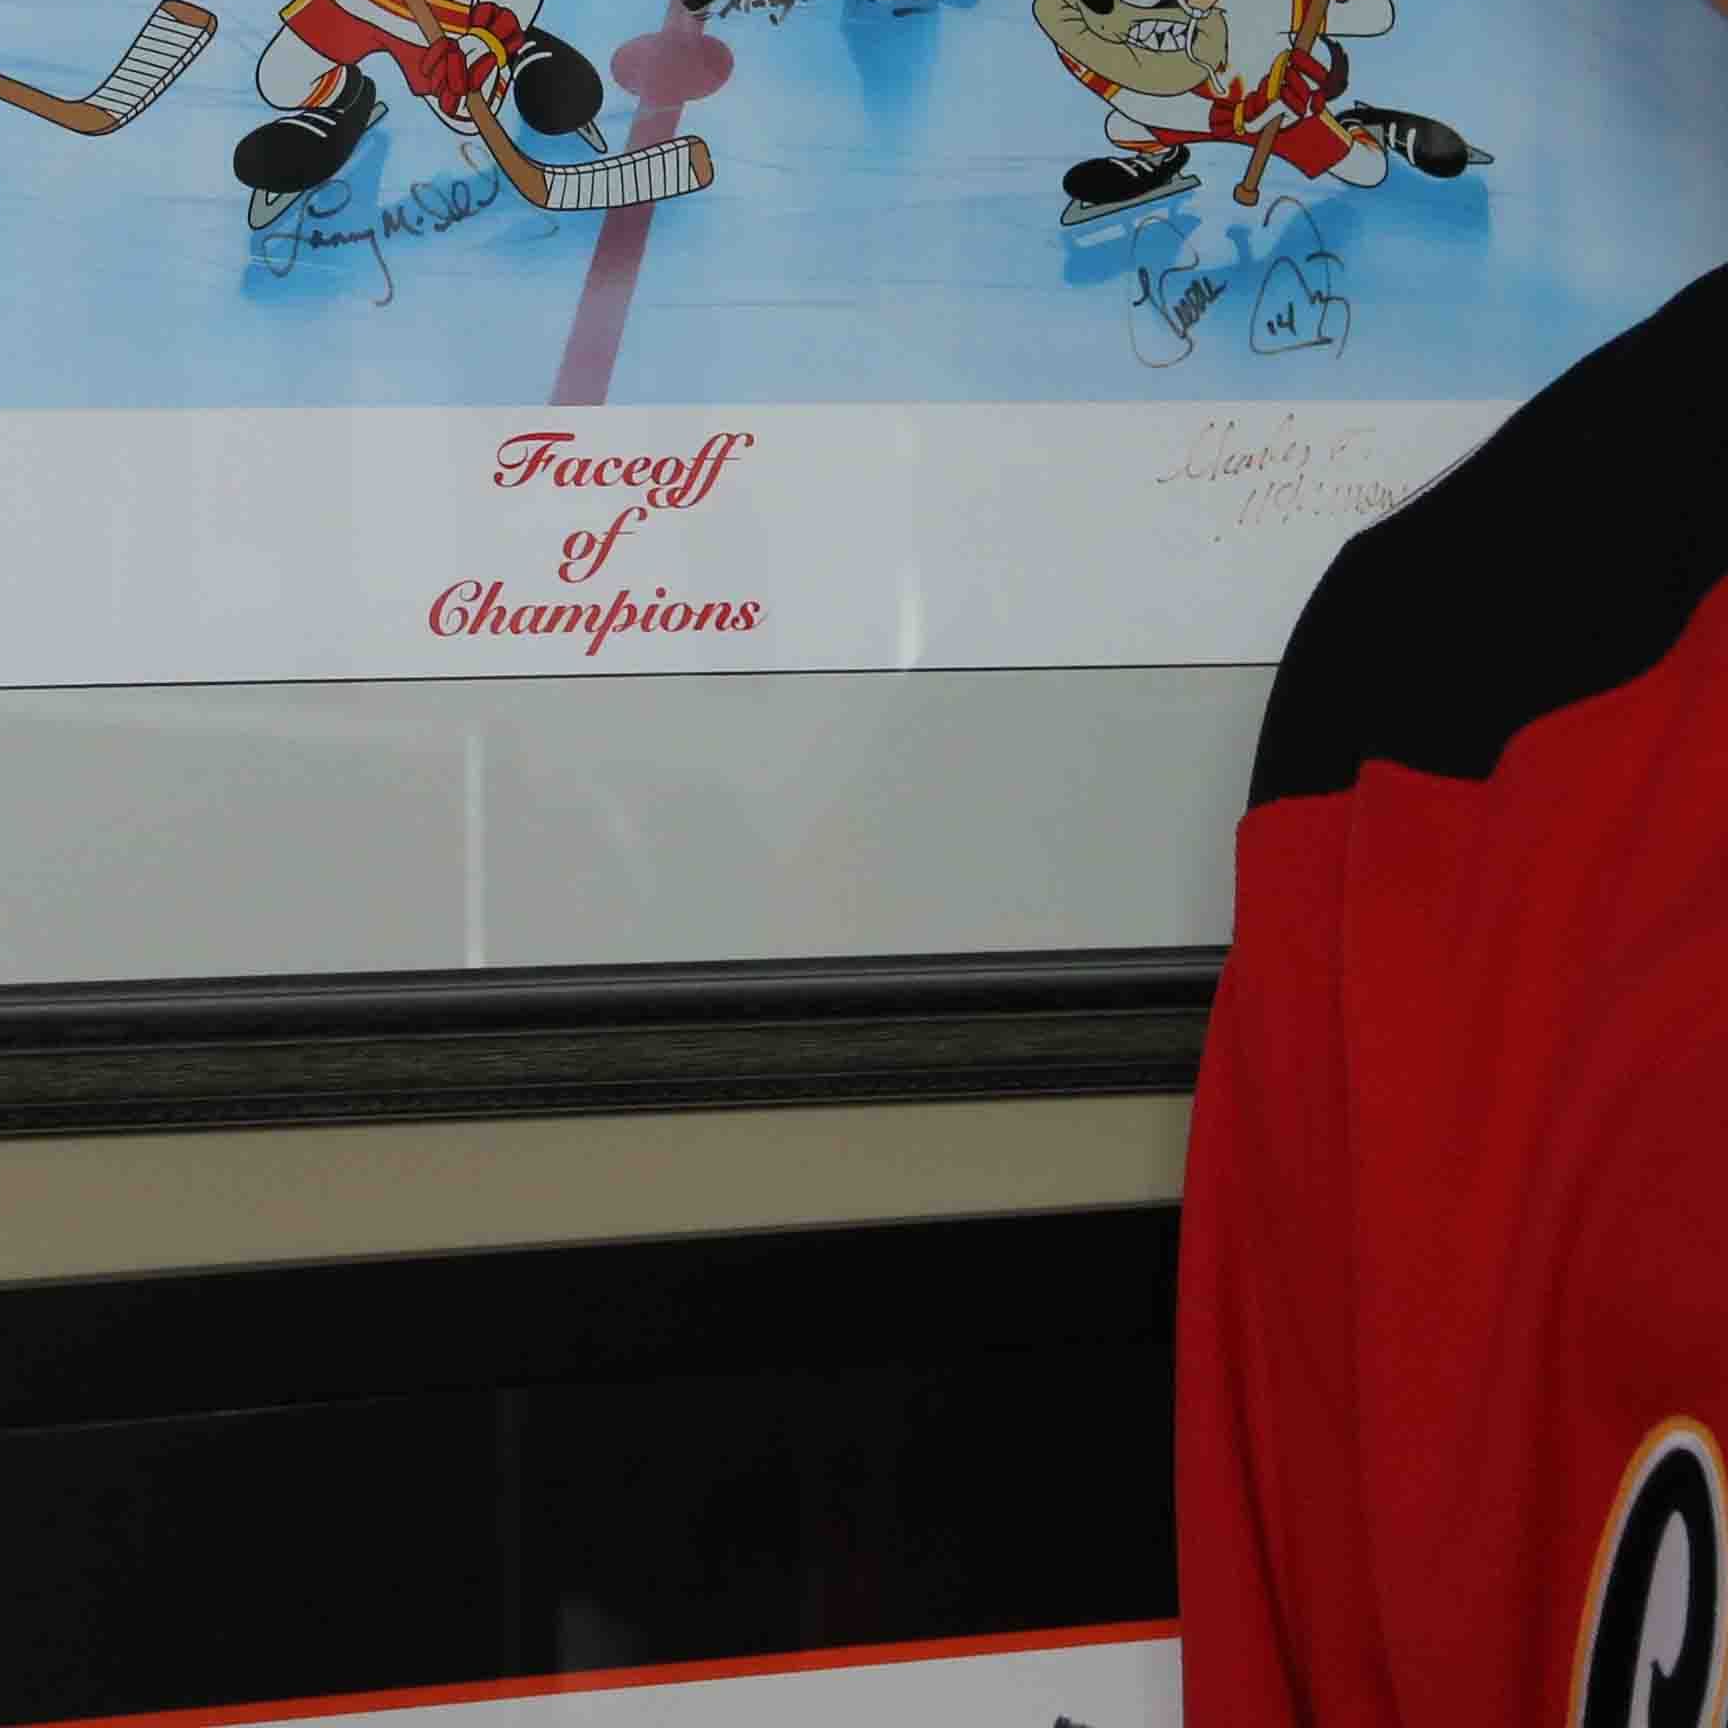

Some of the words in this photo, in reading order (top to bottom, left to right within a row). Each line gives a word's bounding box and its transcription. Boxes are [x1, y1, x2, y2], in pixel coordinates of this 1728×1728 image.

[494, 432, 755, 508] Faceoff
[558, 506, 648, 583] of
[429, 580, 768, 656] Champions
